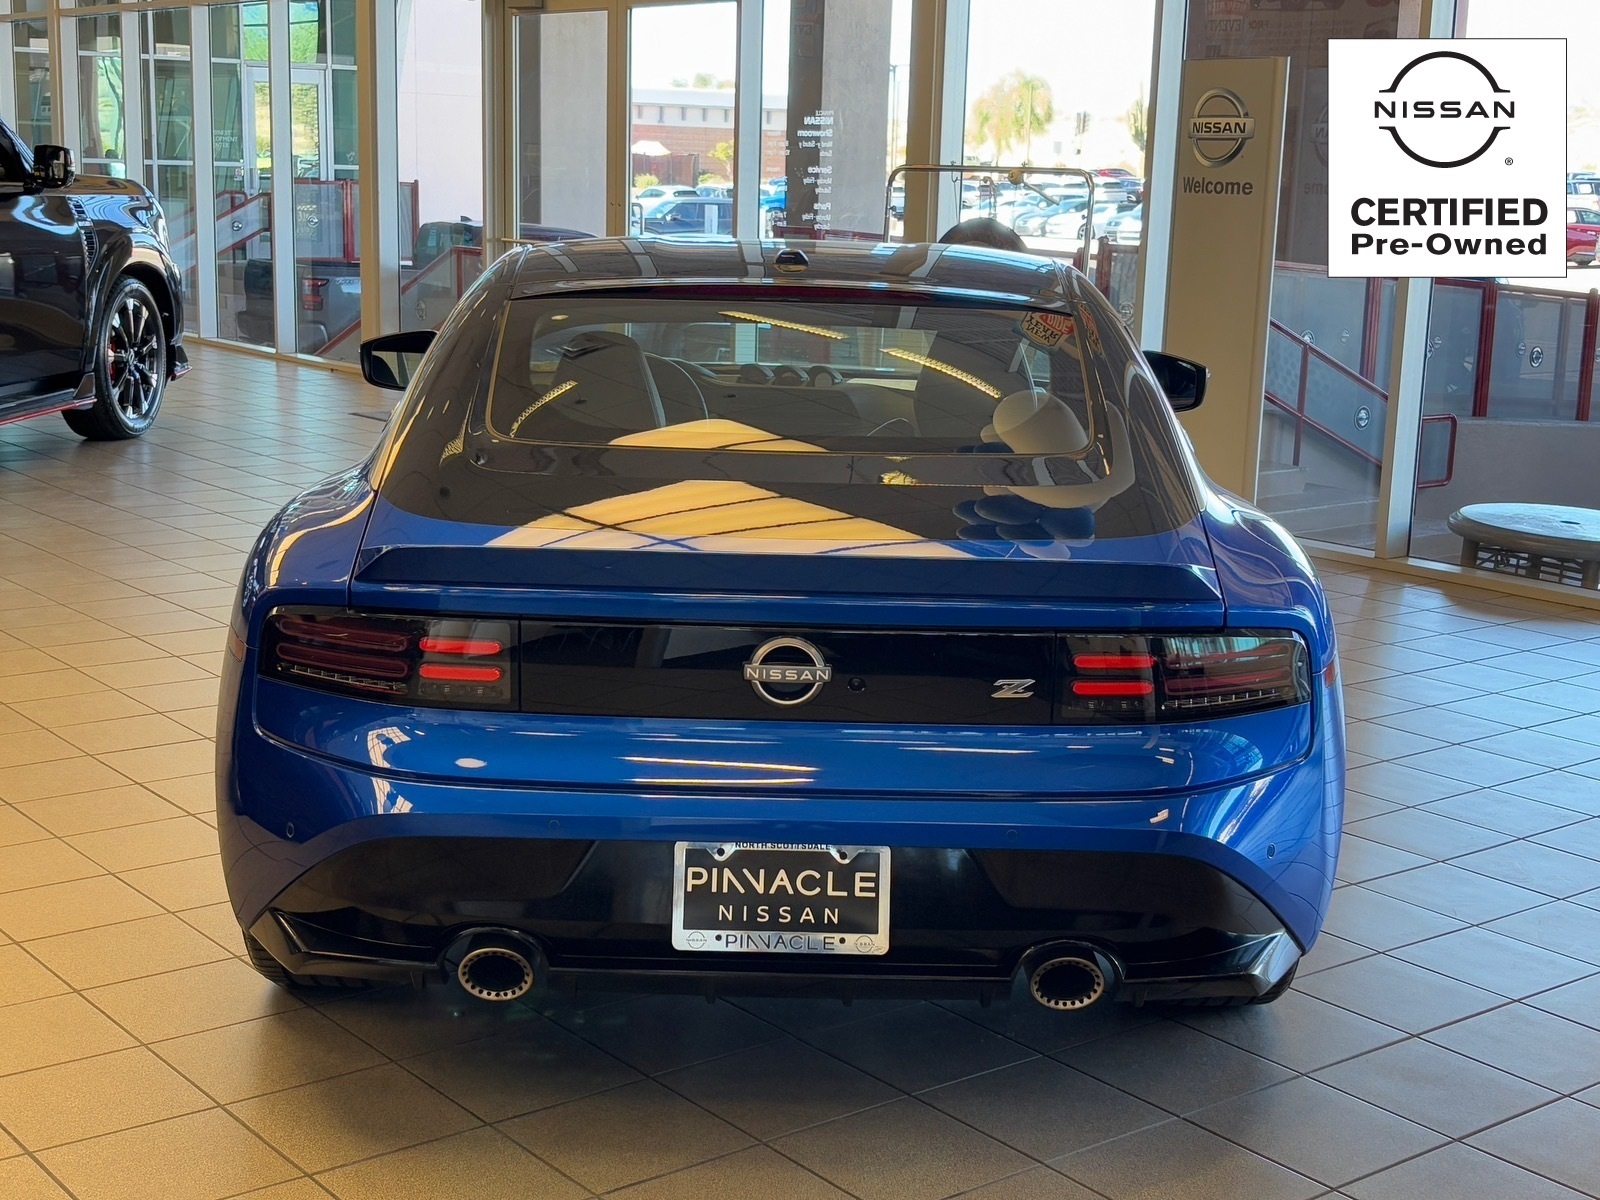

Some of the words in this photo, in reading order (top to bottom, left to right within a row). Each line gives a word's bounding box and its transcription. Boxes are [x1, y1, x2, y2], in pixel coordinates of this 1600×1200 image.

[1192, 121, 1246, 134] NISSAN
[1183, 176, 1254, 196] Welcome
[746, 666, 830, 681] NISSAN
[990, 678, 1036, 698] Z
[686, 866, 877, 898] PINNACLE
[718, 904, 840, 925] NISSAN
[725, 934, 836, 951] PINNACLE
